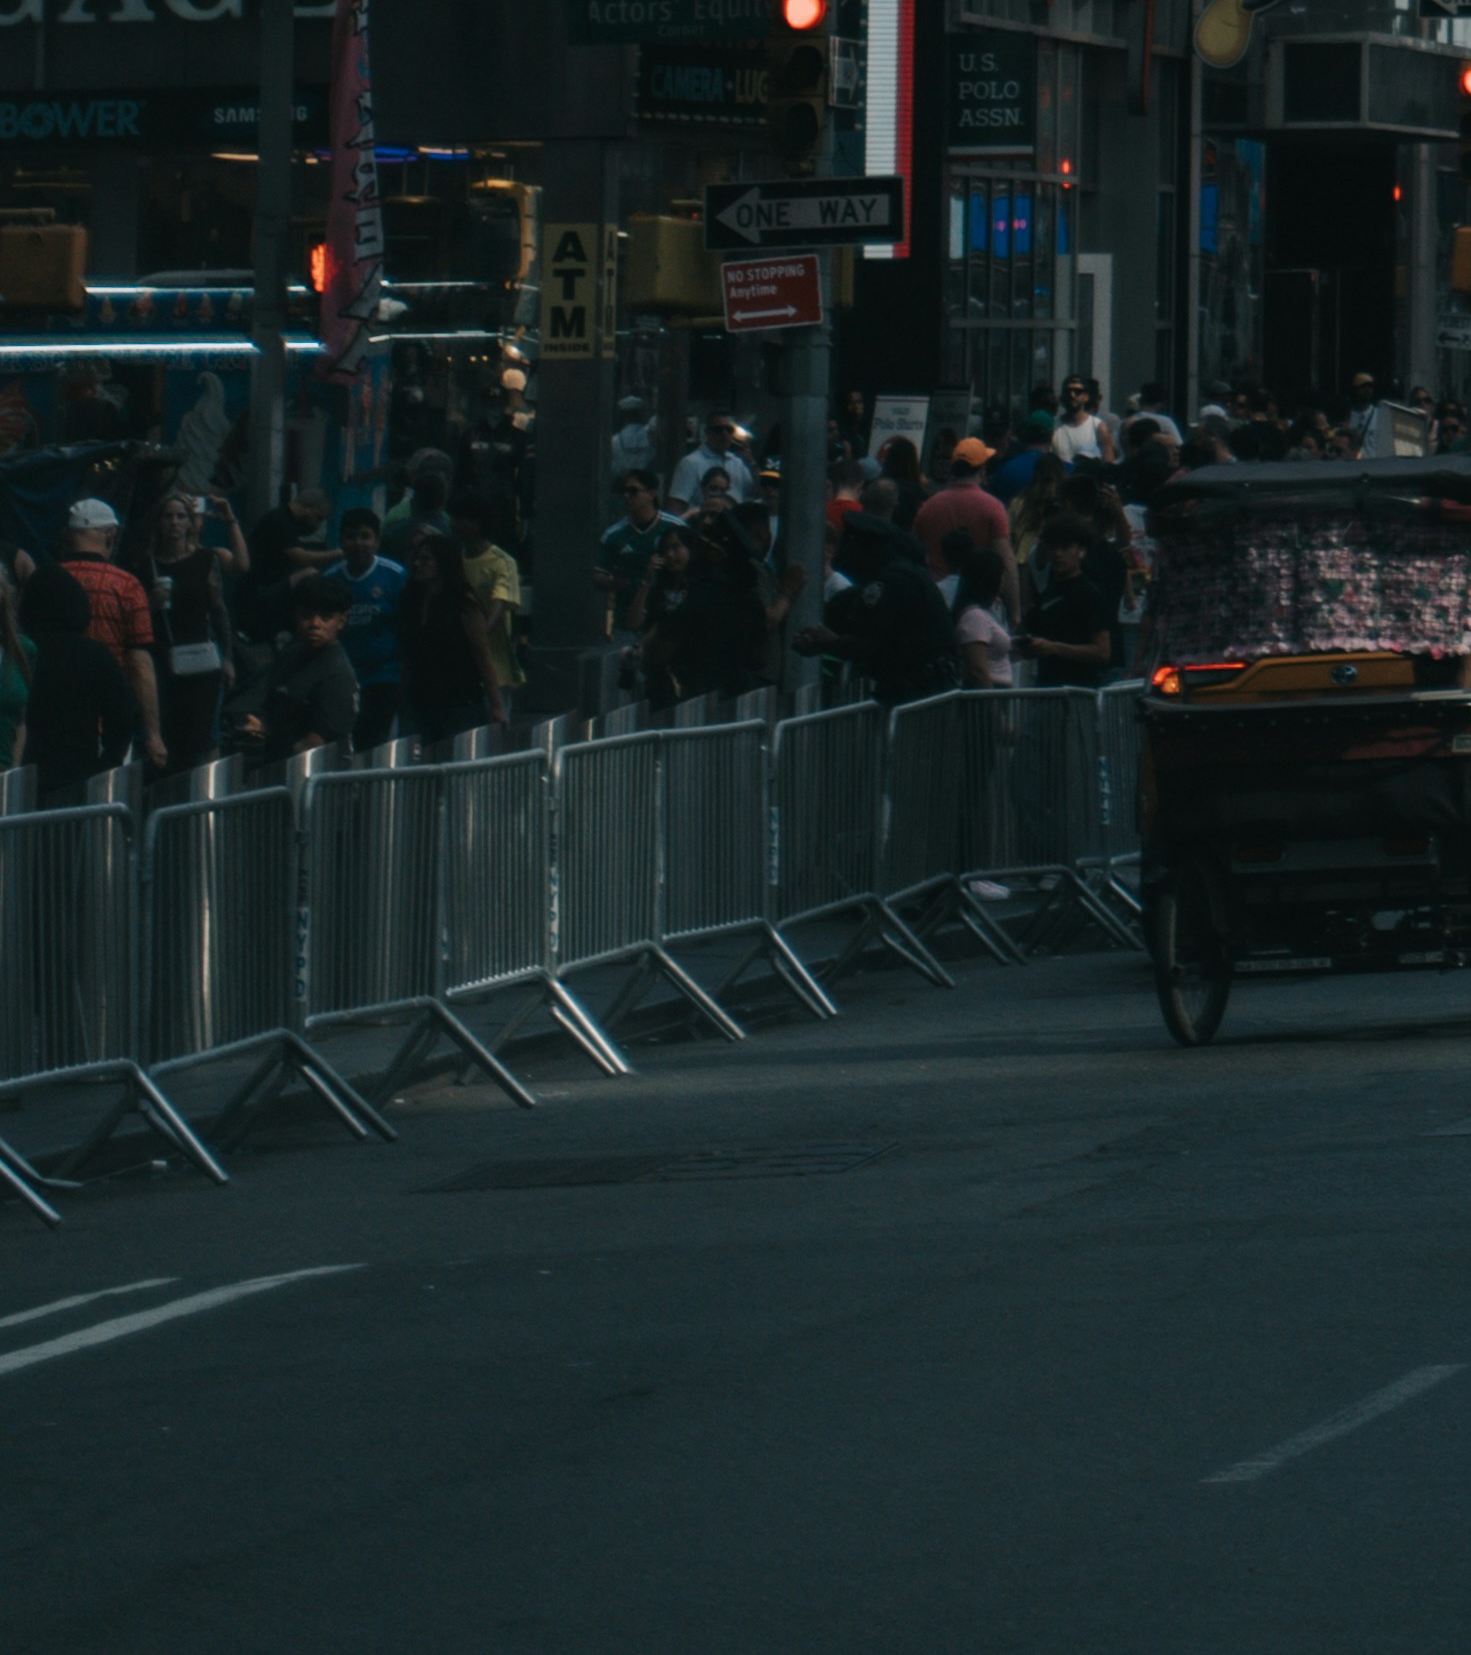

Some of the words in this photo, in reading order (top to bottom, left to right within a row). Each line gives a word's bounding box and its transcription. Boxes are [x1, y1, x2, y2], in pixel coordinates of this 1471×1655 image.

[957, 53, 1000, 75] U.S.
[649, 64, 725, 103] CAMERA
[958, 80, 1021, 101] POLO
[957, 106, 1025, 128] ASSN.
[736, 201, 792, 230] ONE
[818, 197, 878, 226] WAY
[549, 229, 589, 338] ATM
[726, 270, 744, 284] NO
[746, 264, 806, 283] STOPPING
[728, 282, 779, 301] Anytime
[543, 342, 591, 354] INSIDE
